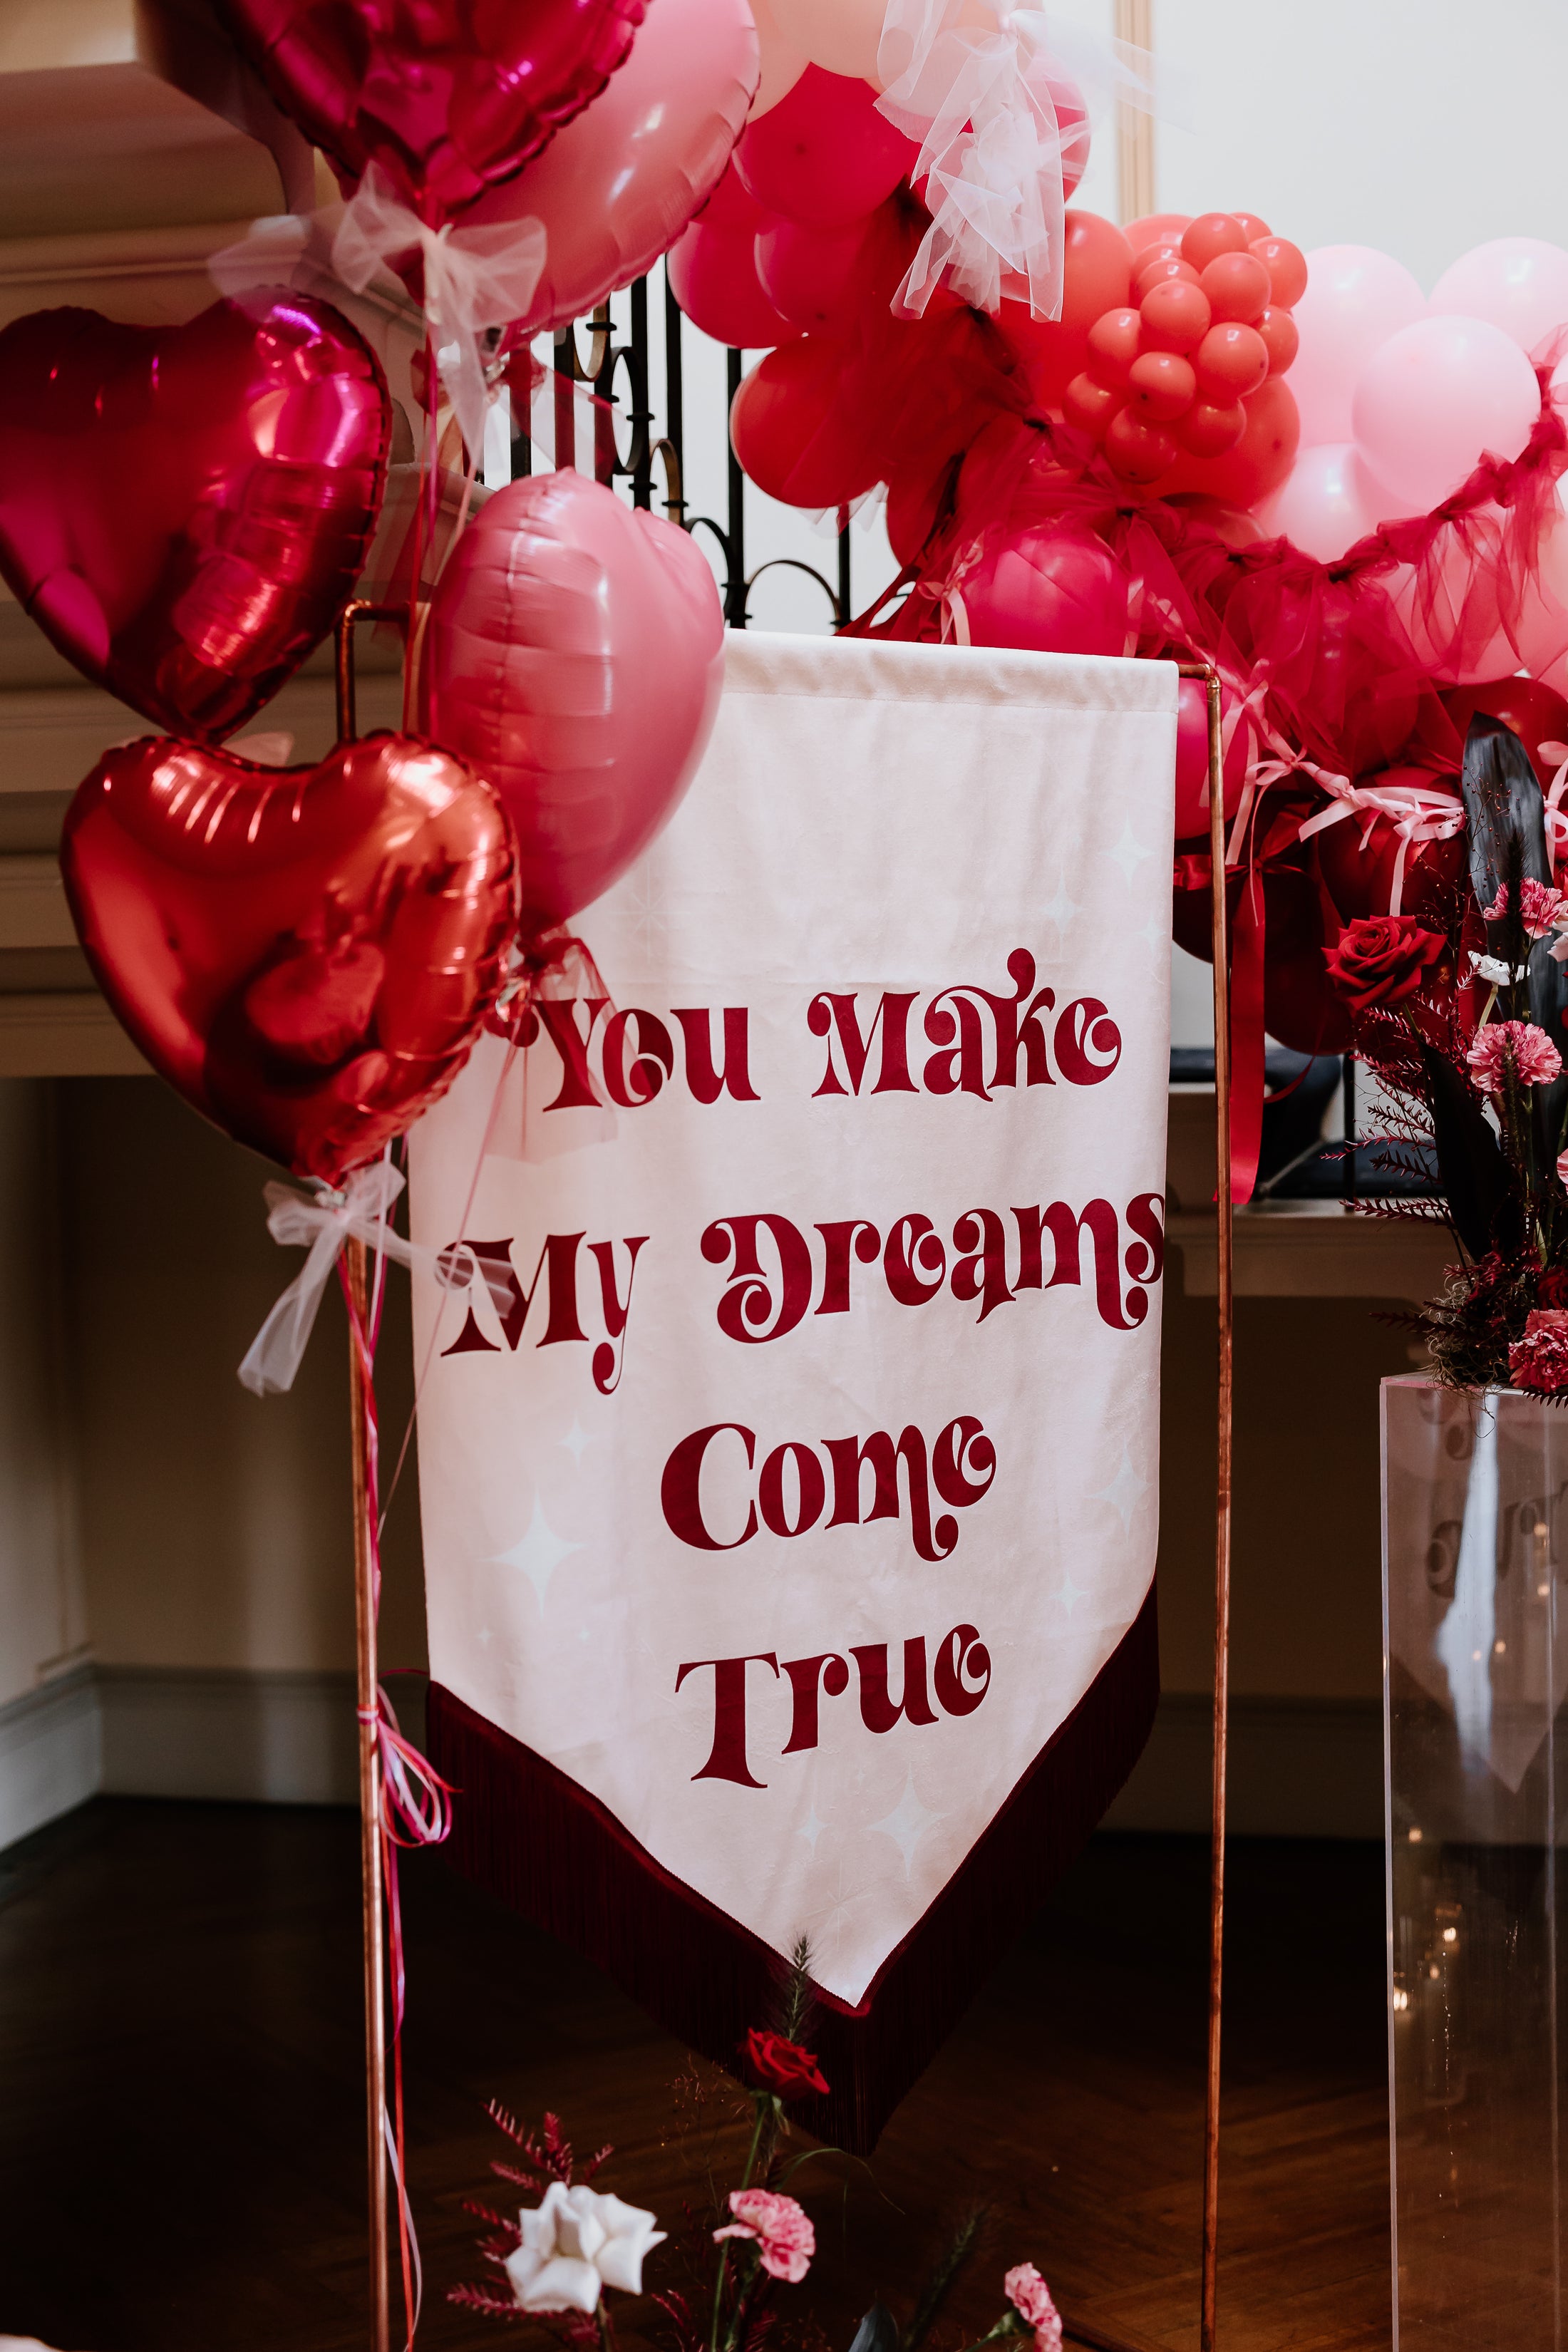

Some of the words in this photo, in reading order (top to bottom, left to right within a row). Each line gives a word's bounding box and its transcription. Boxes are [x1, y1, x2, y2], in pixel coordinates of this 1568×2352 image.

[507, 997, 761, 1113] You
[807, 947, 1122, 1103] Make
[434, 1231, 650, 1396] My
[700, 1192, 1165, 1344] Dreams
[660, 1415, 996, 1562] Come
[674, 1624, 991, 1789] True
